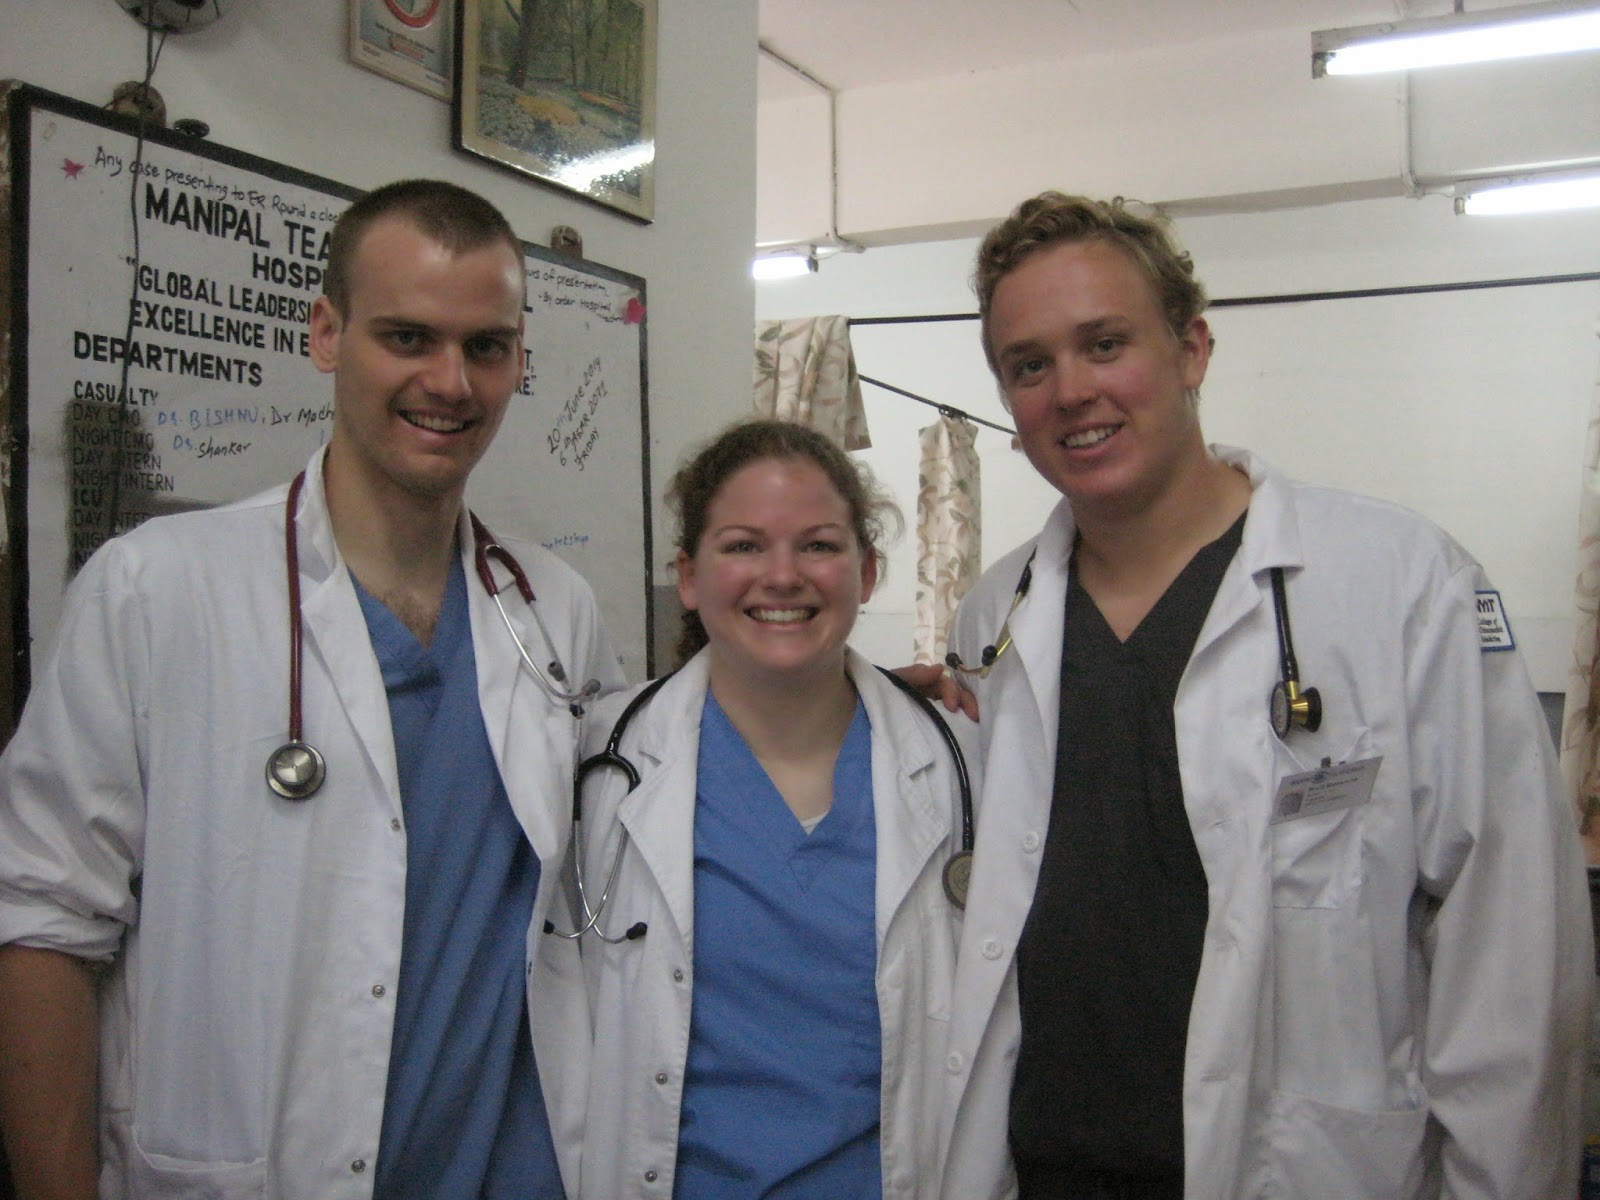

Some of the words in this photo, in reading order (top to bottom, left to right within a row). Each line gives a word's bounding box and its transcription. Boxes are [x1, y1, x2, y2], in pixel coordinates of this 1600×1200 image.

[94, 145, 122, 177] Any
[129, 160, 160, 178] case
[231, 185, 245, 201] to
[145, 182, 271, 249] MANIPAL
[284, 219, 332, 262] TEA
[253, 252, 323, 291] HOSP
[229, 285, 311, 326] LEADERS
[130, 299, 265, 349] EXCELLENCE
[274, 327, 294, 354] IN
[74, 331, 262, 387] DEPARTMENTS
[73, 403, 101, 421] DAY
[74, 380, 158, 406] CASUALTY
[123, 472, 174, 492] INTERN
